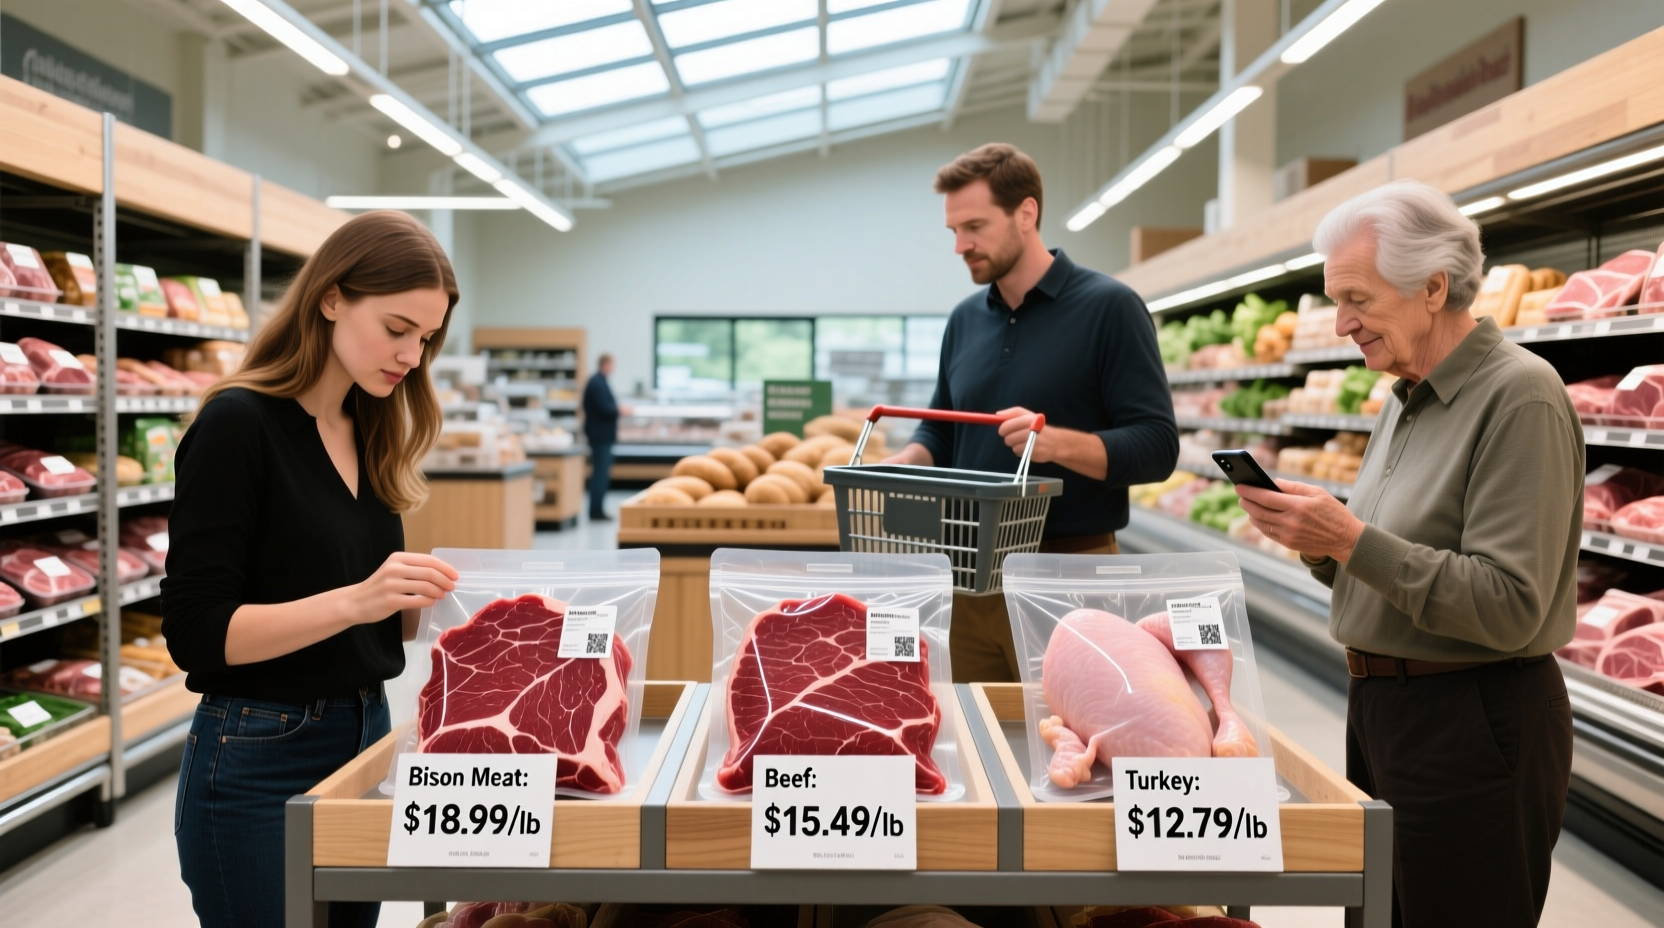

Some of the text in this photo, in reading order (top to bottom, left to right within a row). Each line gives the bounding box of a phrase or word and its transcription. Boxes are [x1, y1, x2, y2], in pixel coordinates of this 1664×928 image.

[409, 766, 528, 787] Bison Meat:
[765, 767, 817, 788] Beef:
[1125, 770, 1200, 795] Turkey:
[403, 801, 541, 836] $18.99/lb
[764, 802, 904, 837] $15.49/lb
[1128, 804, 1268, 839] $12.79/lb
